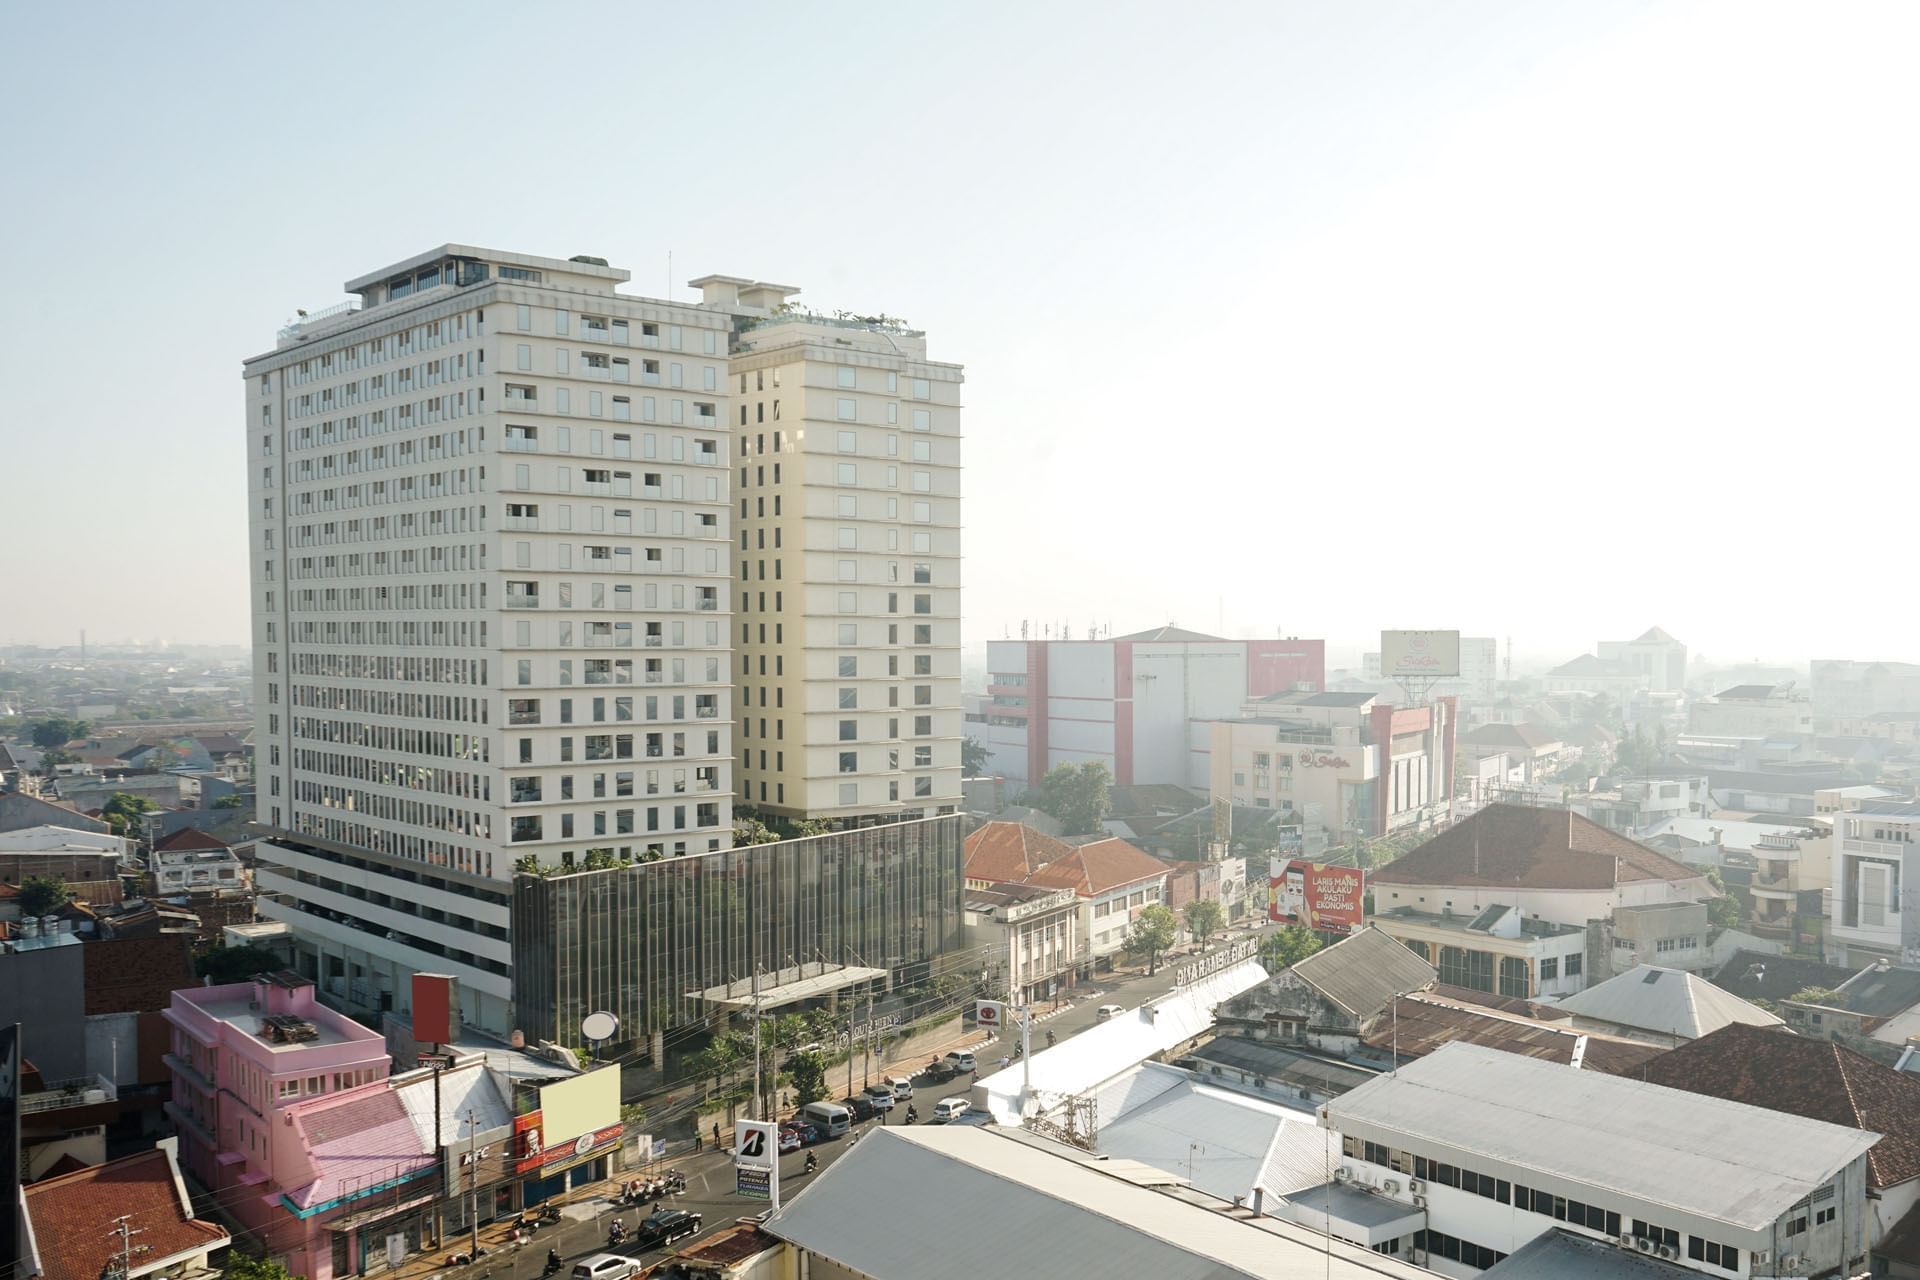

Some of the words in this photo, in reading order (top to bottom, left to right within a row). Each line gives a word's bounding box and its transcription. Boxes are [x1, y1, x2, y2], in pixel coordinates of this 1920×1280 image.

[1312, 877, 1333, 886] LARIS
[1334, 877, 1358, 887] MANIS
[1317, 884, 1353, 895] AKULAKU
[1324, 893, 1345, 902] PASTI
[1316, 901, 1354, 911] EKONOMIS
[463, 1146, 490, 1166] KFC
